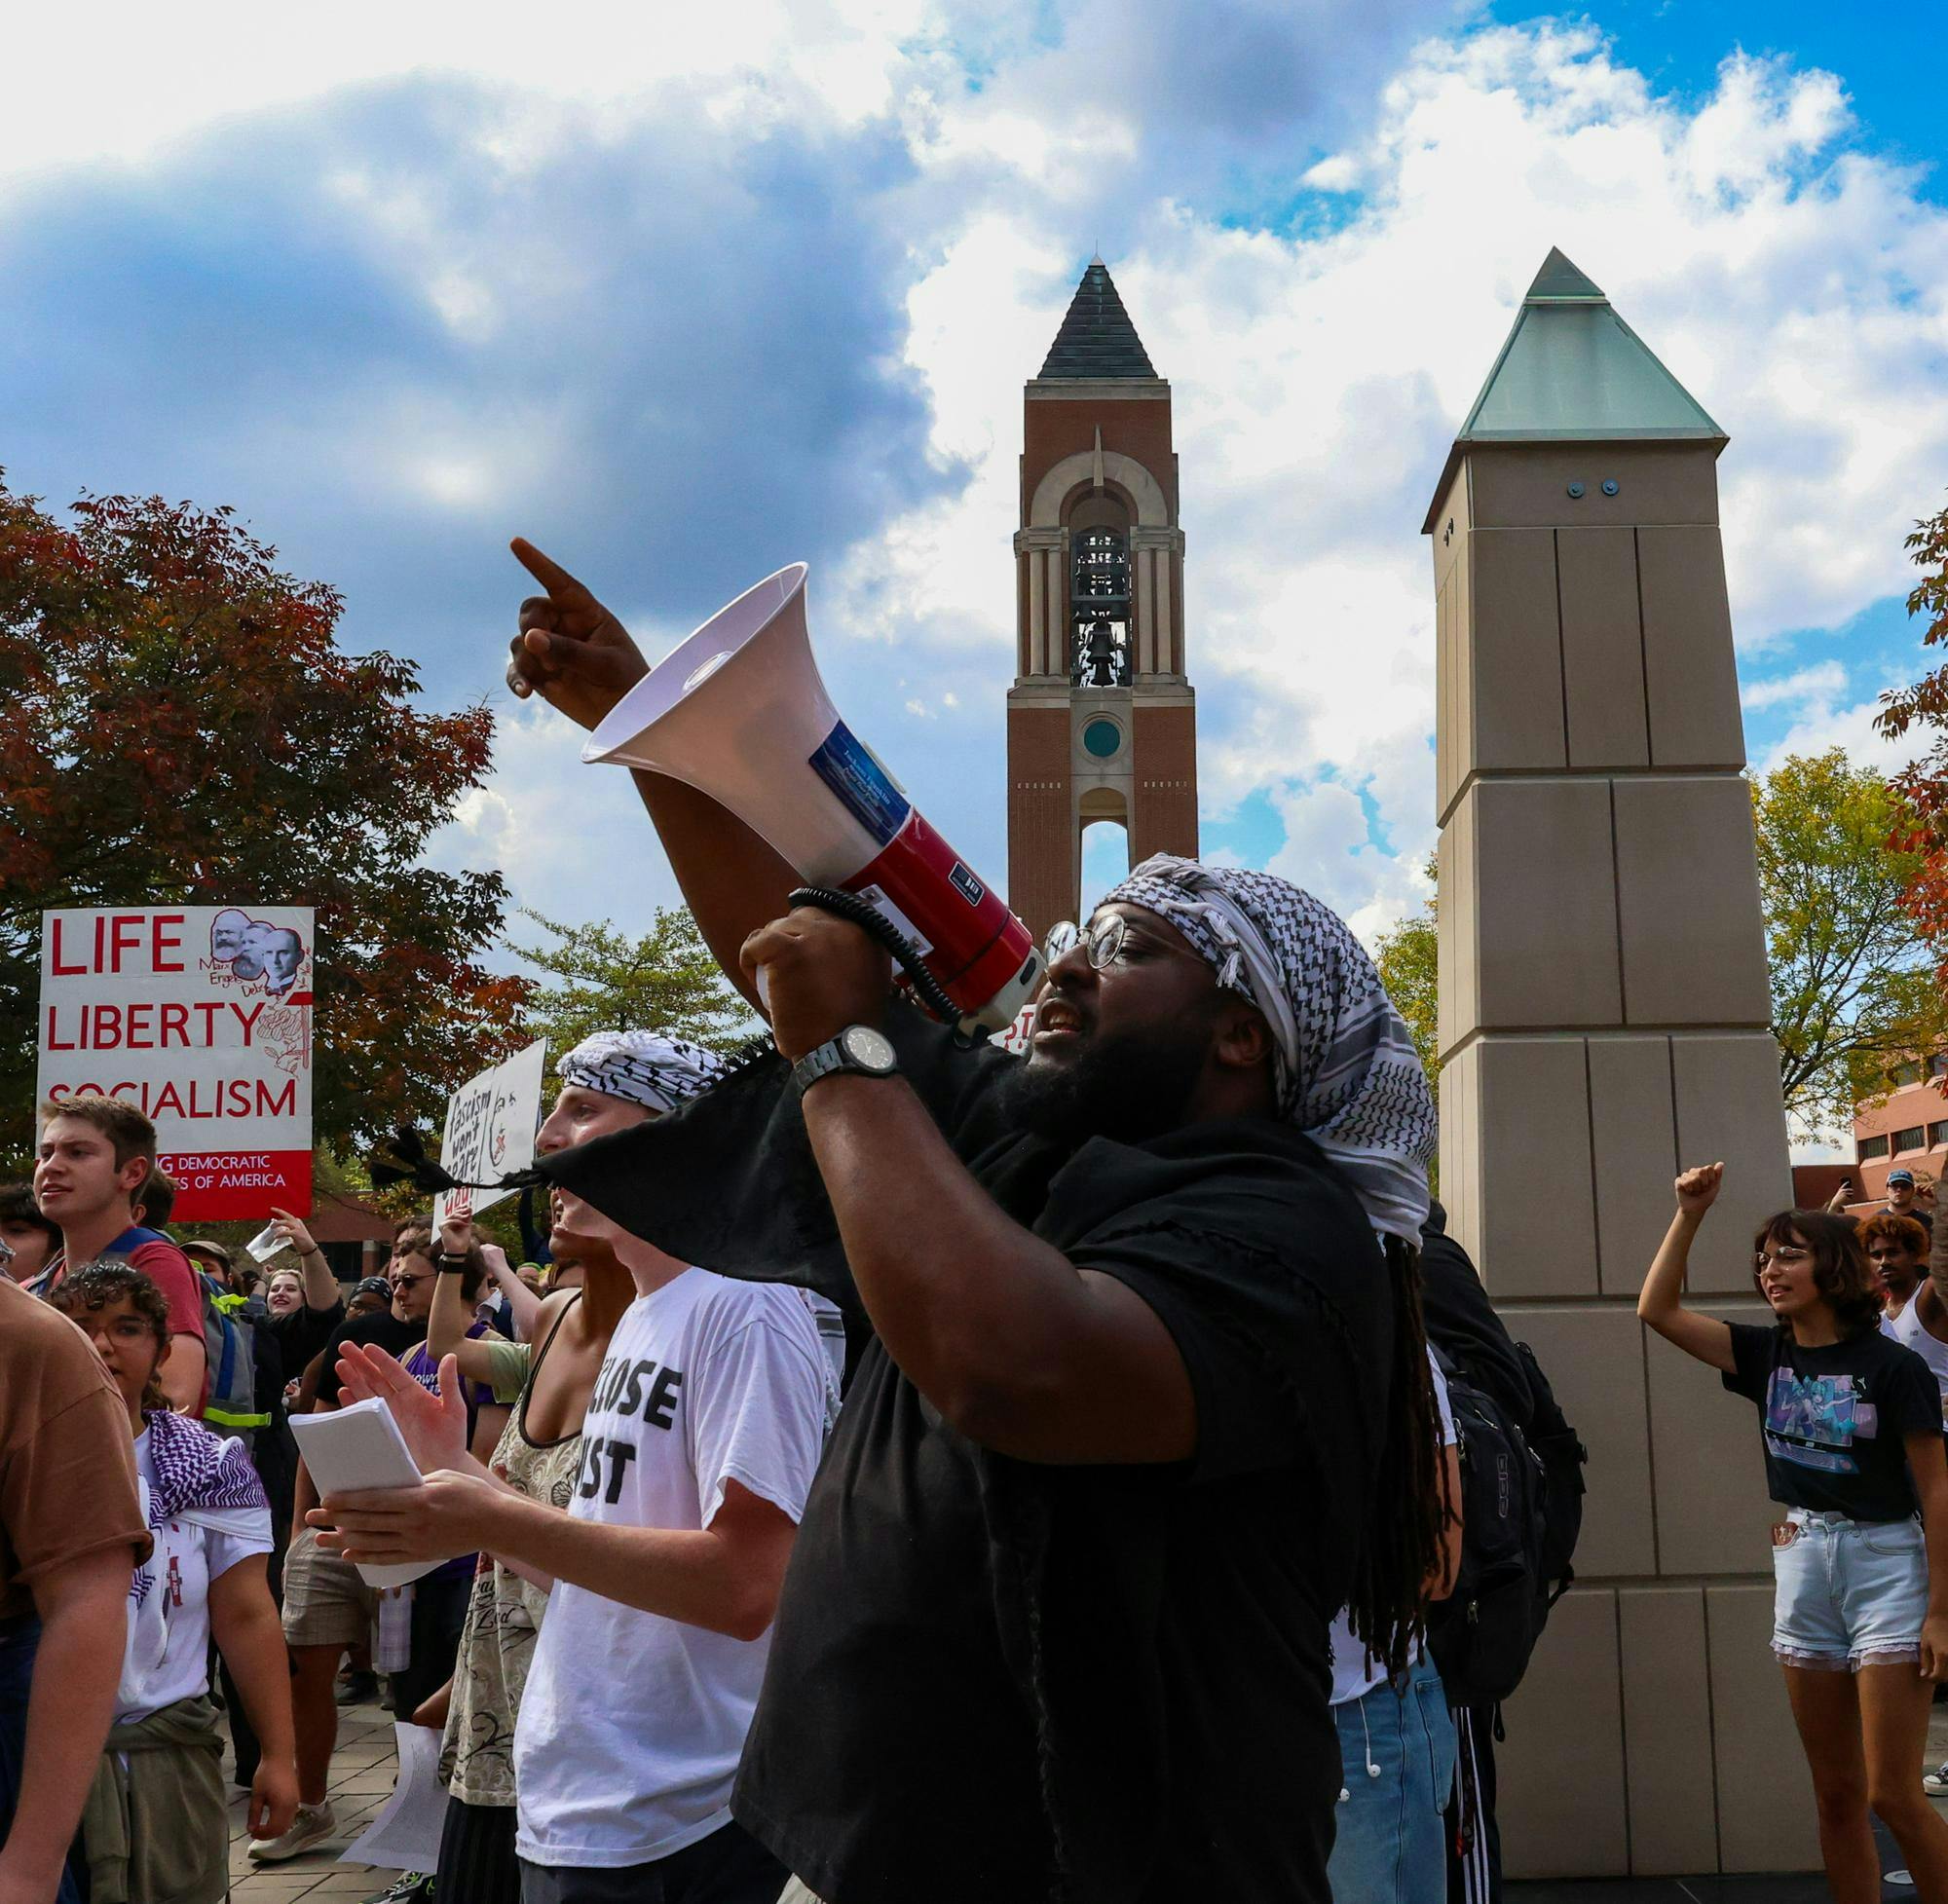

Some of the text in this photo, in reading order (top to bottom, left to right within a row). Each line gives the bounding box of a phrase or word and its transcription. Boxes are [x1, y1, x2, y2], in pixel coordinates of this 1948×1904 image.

[52, 915, 185, 976] LIFE
[48, 1002, 266, 1051] LIBERTY
[449, 1089, 491, 1142] fascism
[178, 1155, 271, 1170] DEMOCRATIC
[195, 1176, 214, 1189] OF
[219, 1174, 285, 1188] AMERICA
